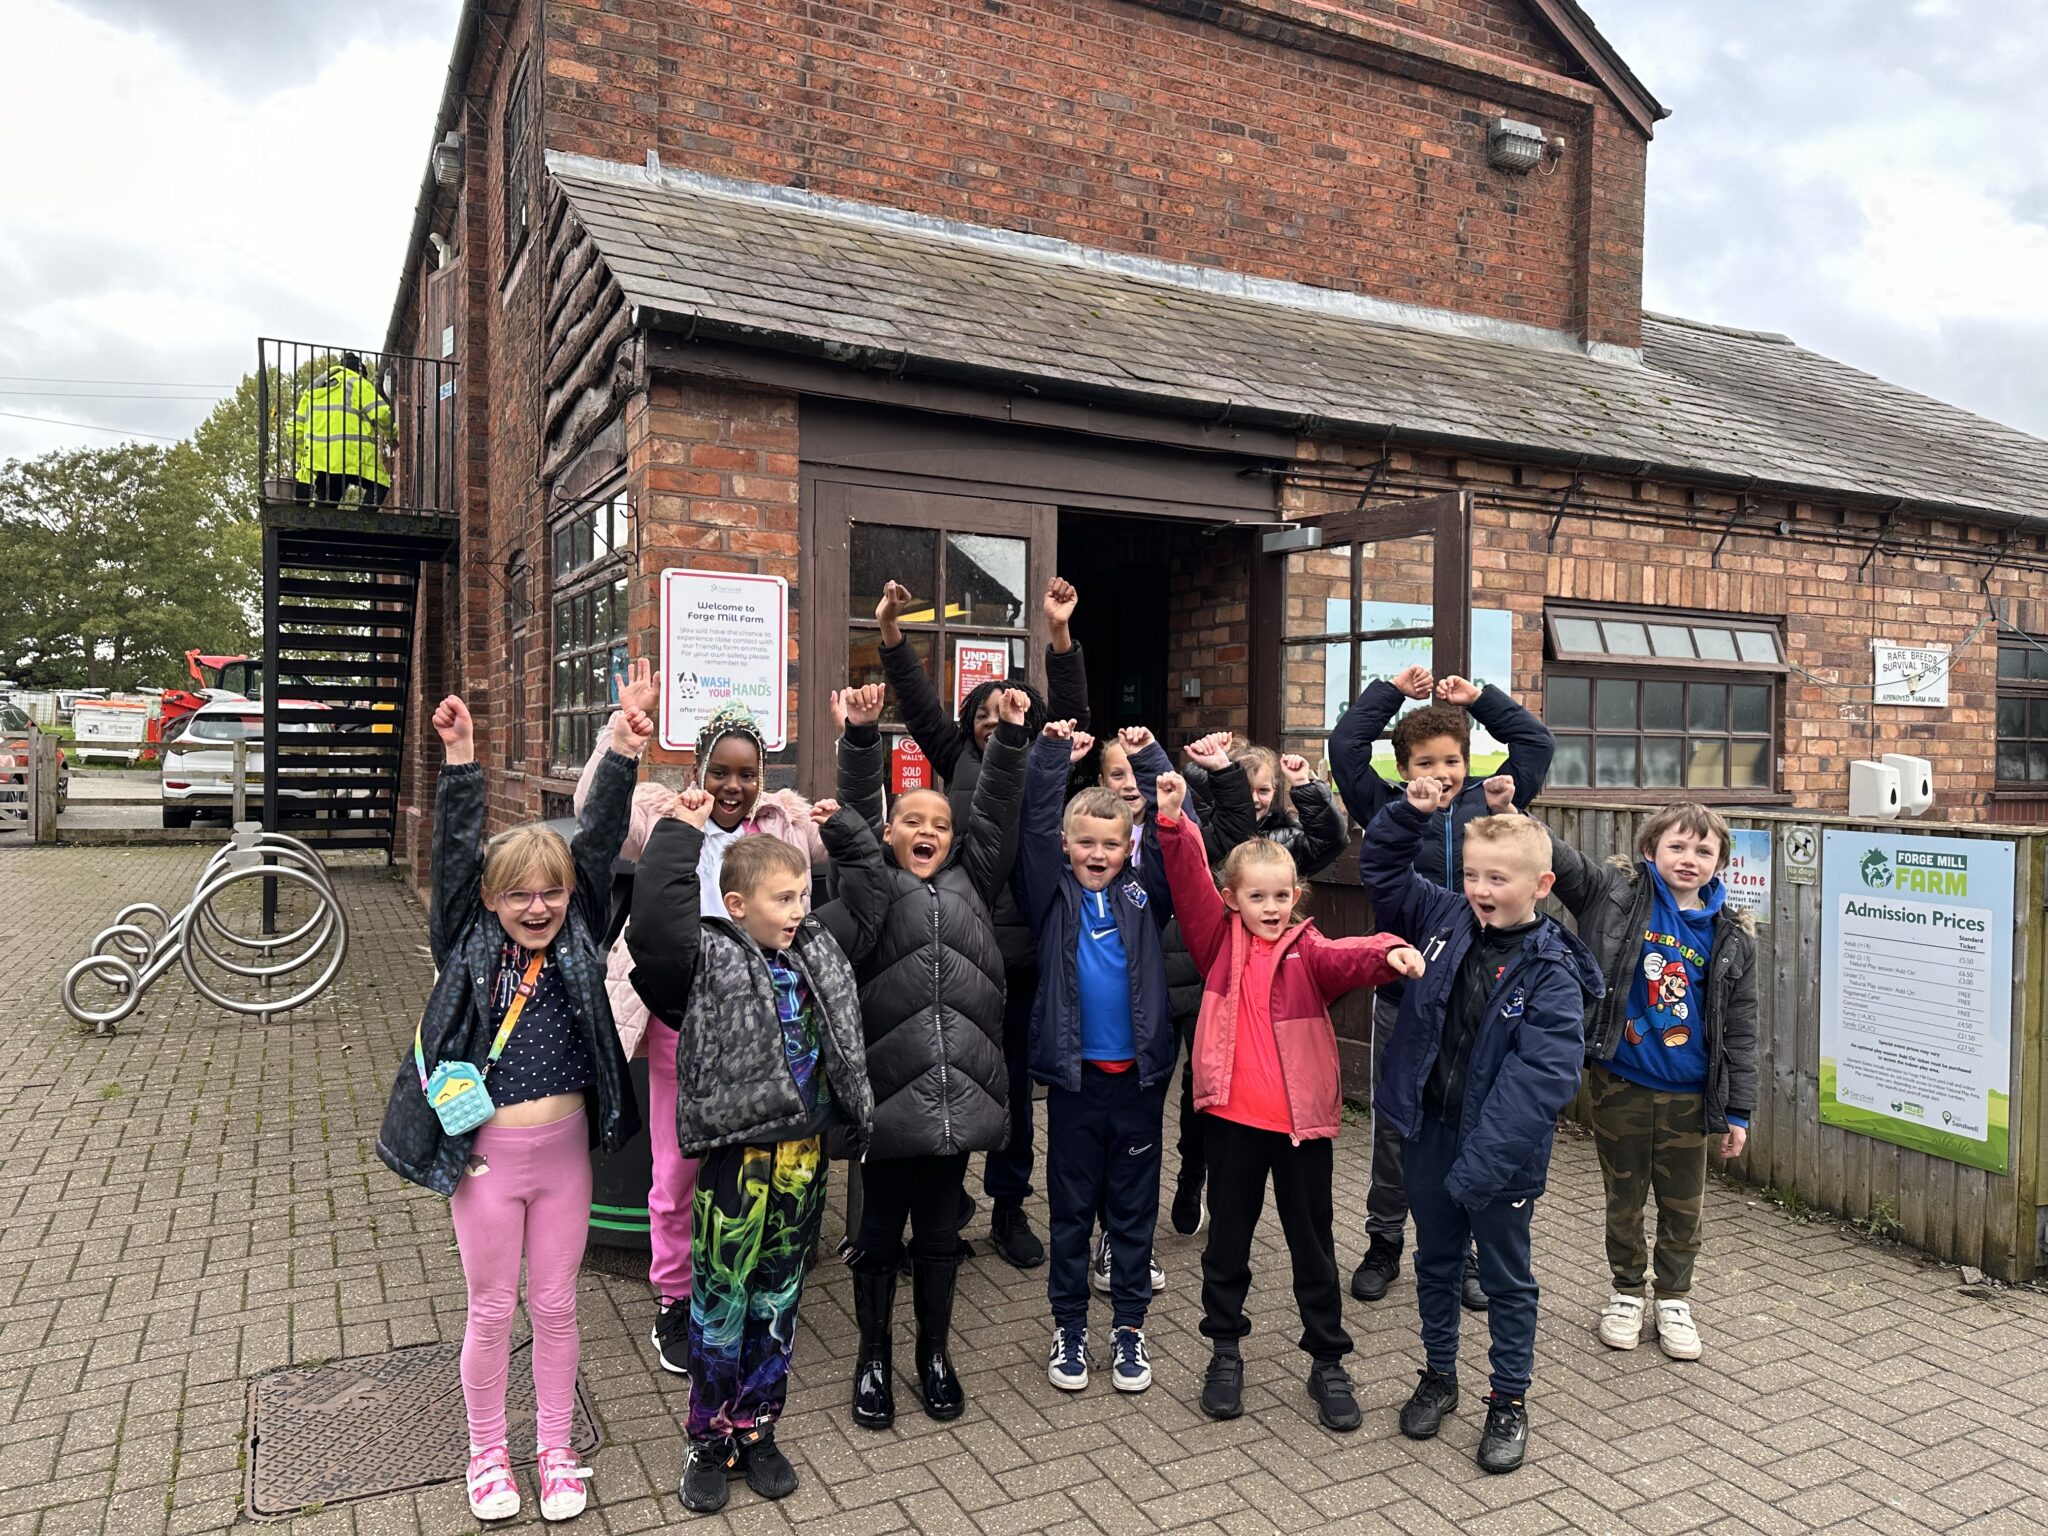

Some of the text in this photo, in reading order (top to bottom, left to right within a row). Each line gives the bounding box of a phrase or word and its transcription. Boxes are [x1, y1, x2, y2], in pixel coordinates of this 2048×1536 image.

[697, 601, 755, 613] Welcome to
[687, 612, 764, 624] Forge Mill Farm
[962, 650, 1003, 662] UNDER
[1887, 651, 1938, 664] RARE BREEDS
[961, 660, 983, 671] 25?
[1882, 661, 1941, 675] SURVIVAL TRUST
[700, 676, 731, 688] WASH
[708, 688, 731, 698] YOUR
[732, 683, 772, 697] HANDS
[1882, 694, 1910, 702] APPROVED
[1911, 694, 1926, 702] FARM
[902, 766, 921, 777] SOLD
[902, 777, 921, 788] HERE!
[1897, 852, 1966, 869] FORGE MILL
[1787, 866, 1815, 877] No dogs
[1733, 872, 1766, 886] Zone
[1895, 867, 1967, 897] FARM
[1844, 900, 1985, 932] Admission Prices
[1959, 935, 1983, 944] Standard
[1644, 930, 1705, 967] UPER ARIO
[1959, 942, 1976, 950] Ticket
[1957, 998, 1971, 1006] FREE
[1957, 1010, 1971, 1018] FREE
[1951, 1121, 1979, 1132] Sandwell
